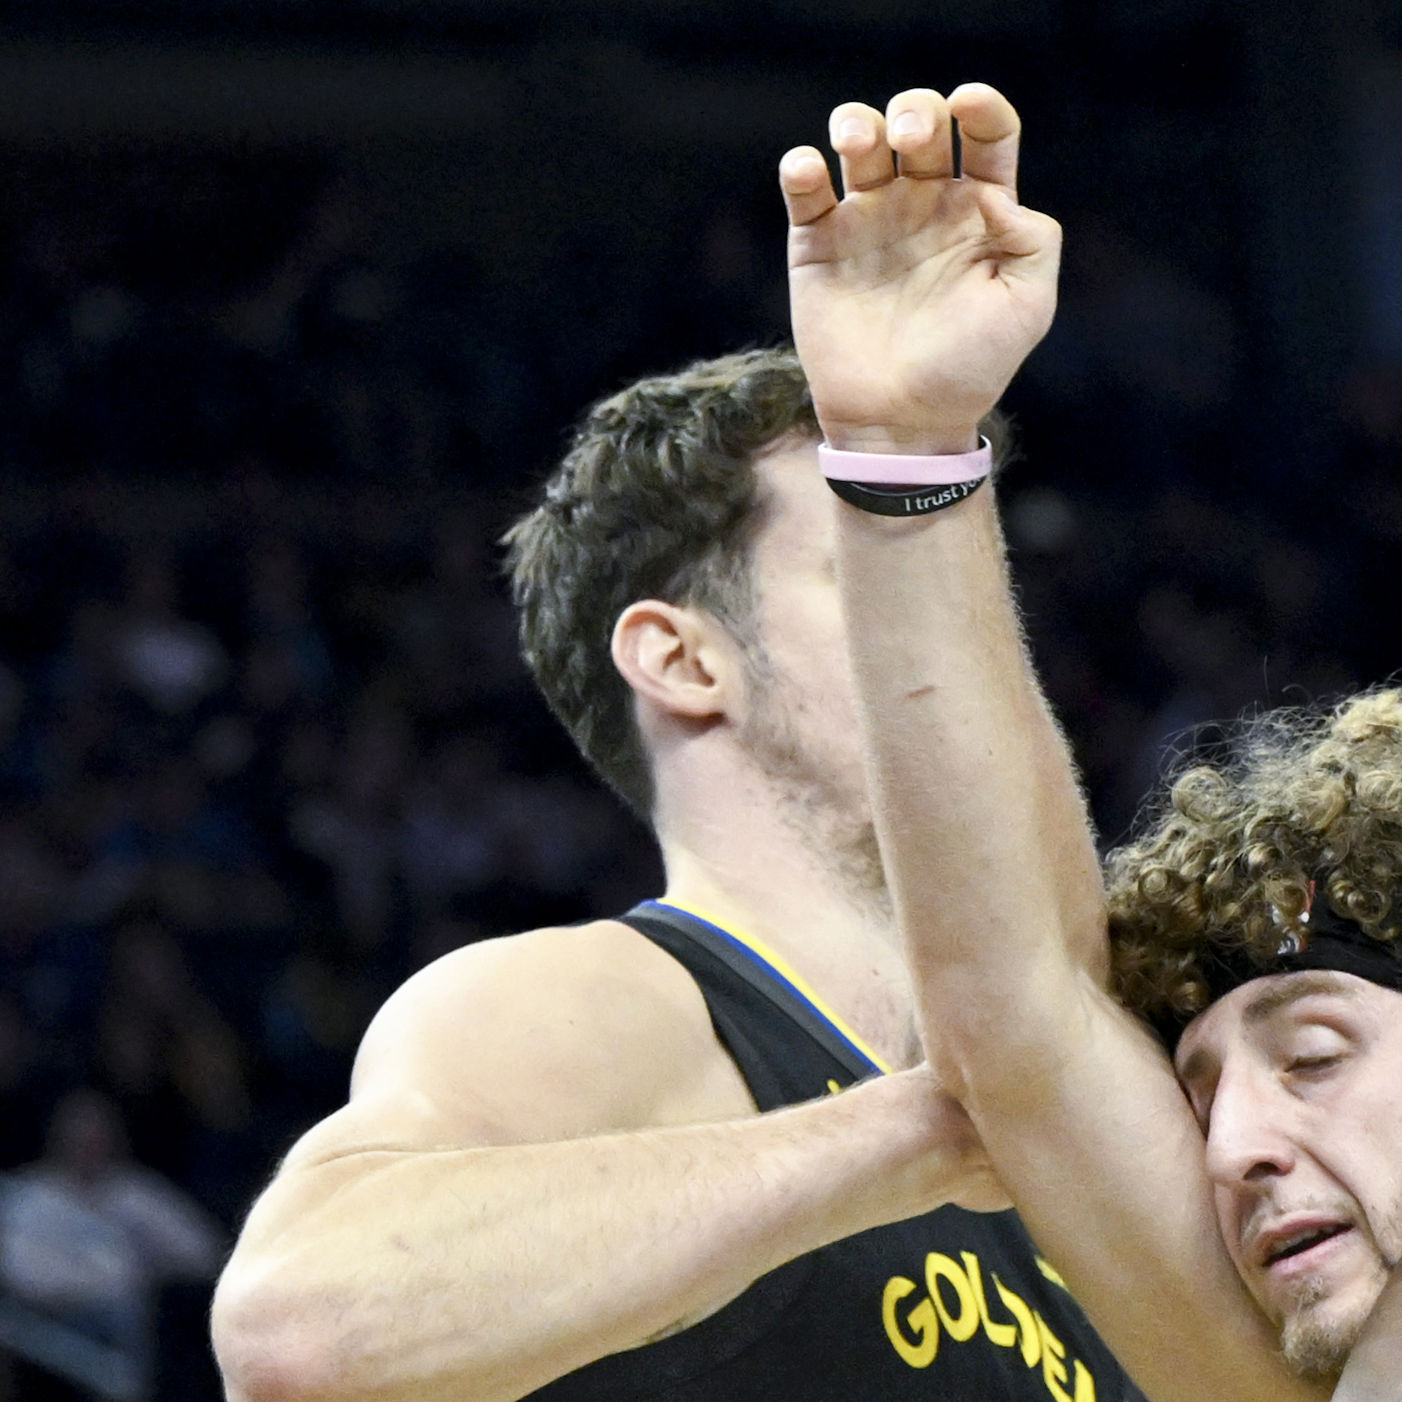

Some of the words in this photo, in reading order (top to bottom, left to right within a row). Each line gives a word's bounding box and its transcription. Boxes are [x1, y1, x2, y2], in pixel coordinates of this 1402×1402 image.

[905, 498, 911, 512] I
[916, 484, 959, 510] trust
[960, 478, 981, 496] yo
